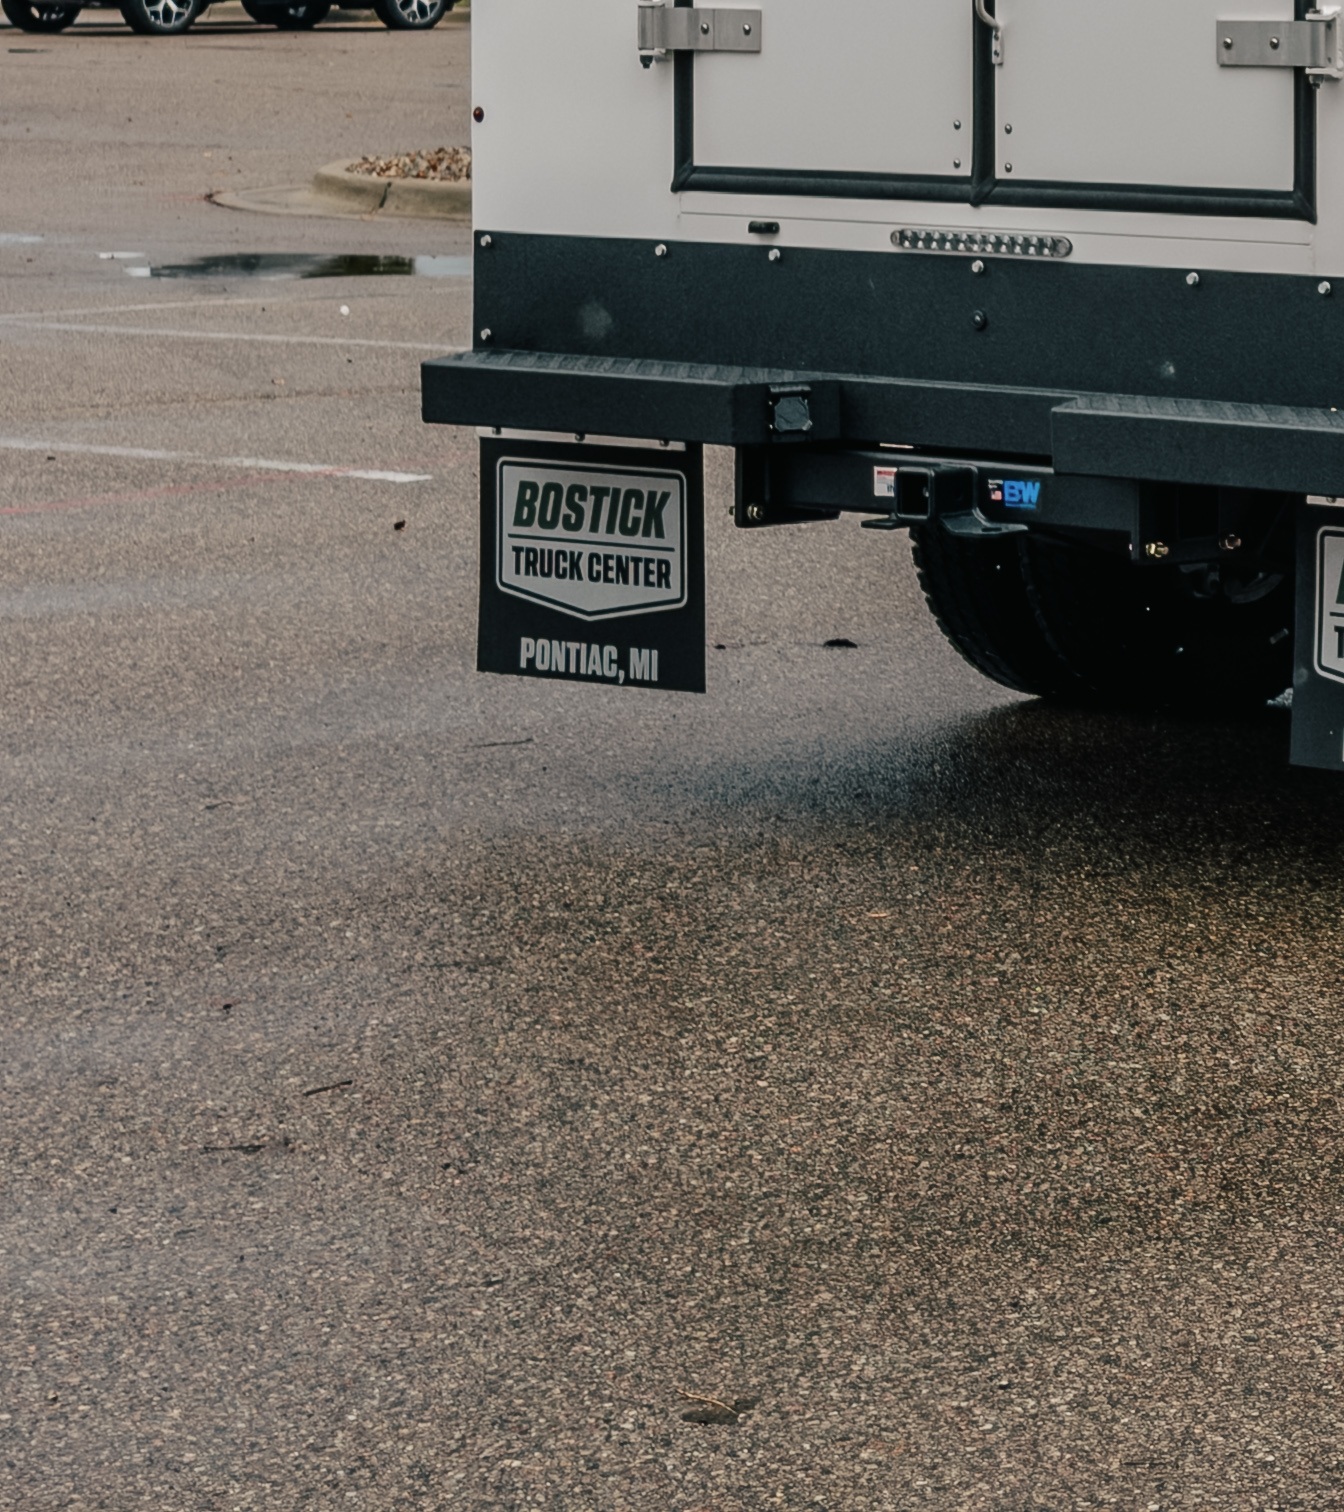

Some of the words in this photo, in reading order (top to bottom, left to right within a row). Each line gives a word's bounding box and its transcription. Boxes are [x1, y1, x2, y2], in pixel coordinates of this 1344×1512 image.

[512, 479, 671, 539] BOSTICK
[512, 545, 583, 581] TRUCK
[588, 552, 671, 589] CENTER
[520, 637, 625, 684] PONTIAC,
[629, 648, 659, 681] MI
